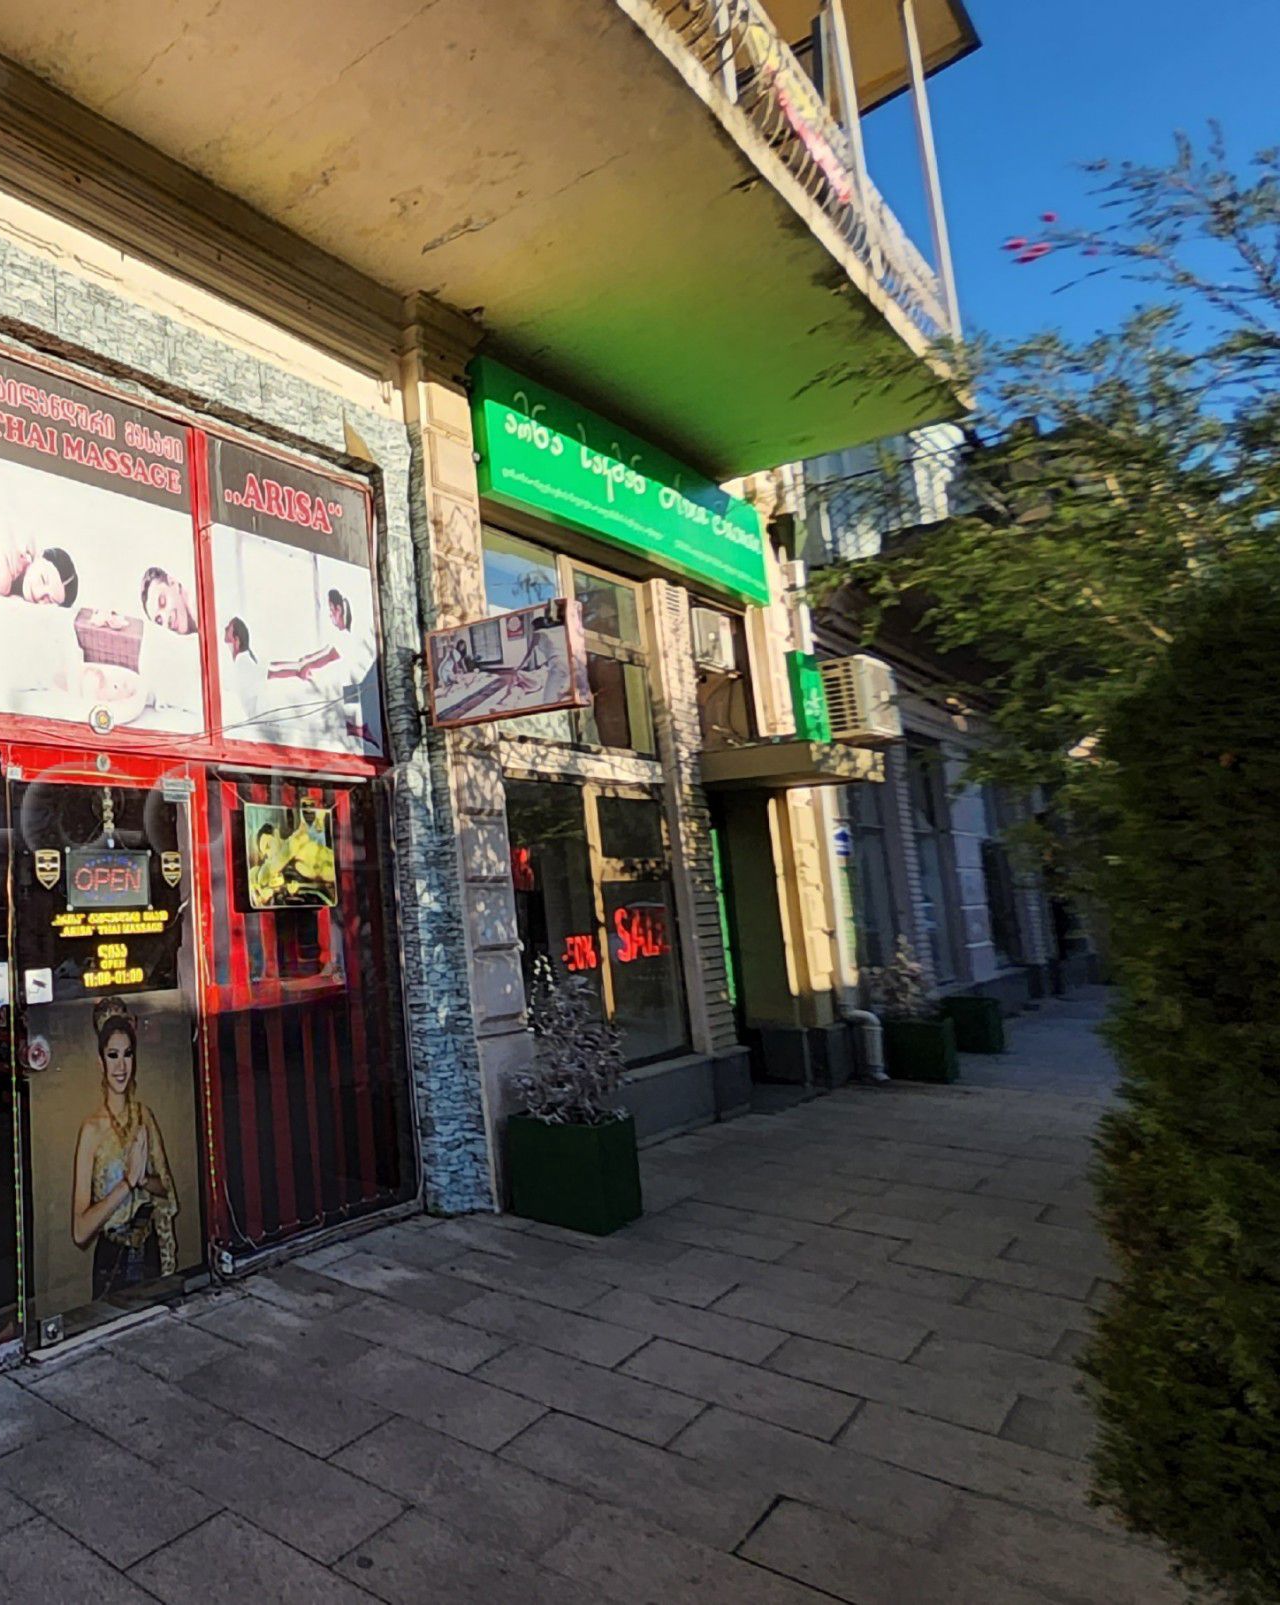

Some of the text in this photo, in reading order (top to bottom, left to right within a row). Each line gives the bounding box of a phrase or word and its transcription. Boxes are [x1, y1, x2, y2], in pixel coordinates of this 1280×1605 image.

[62, 432, 181, 494] MASSAGE
[74, 867, 144, 892] OPEN
[614, 907, 671, 962] SALE
